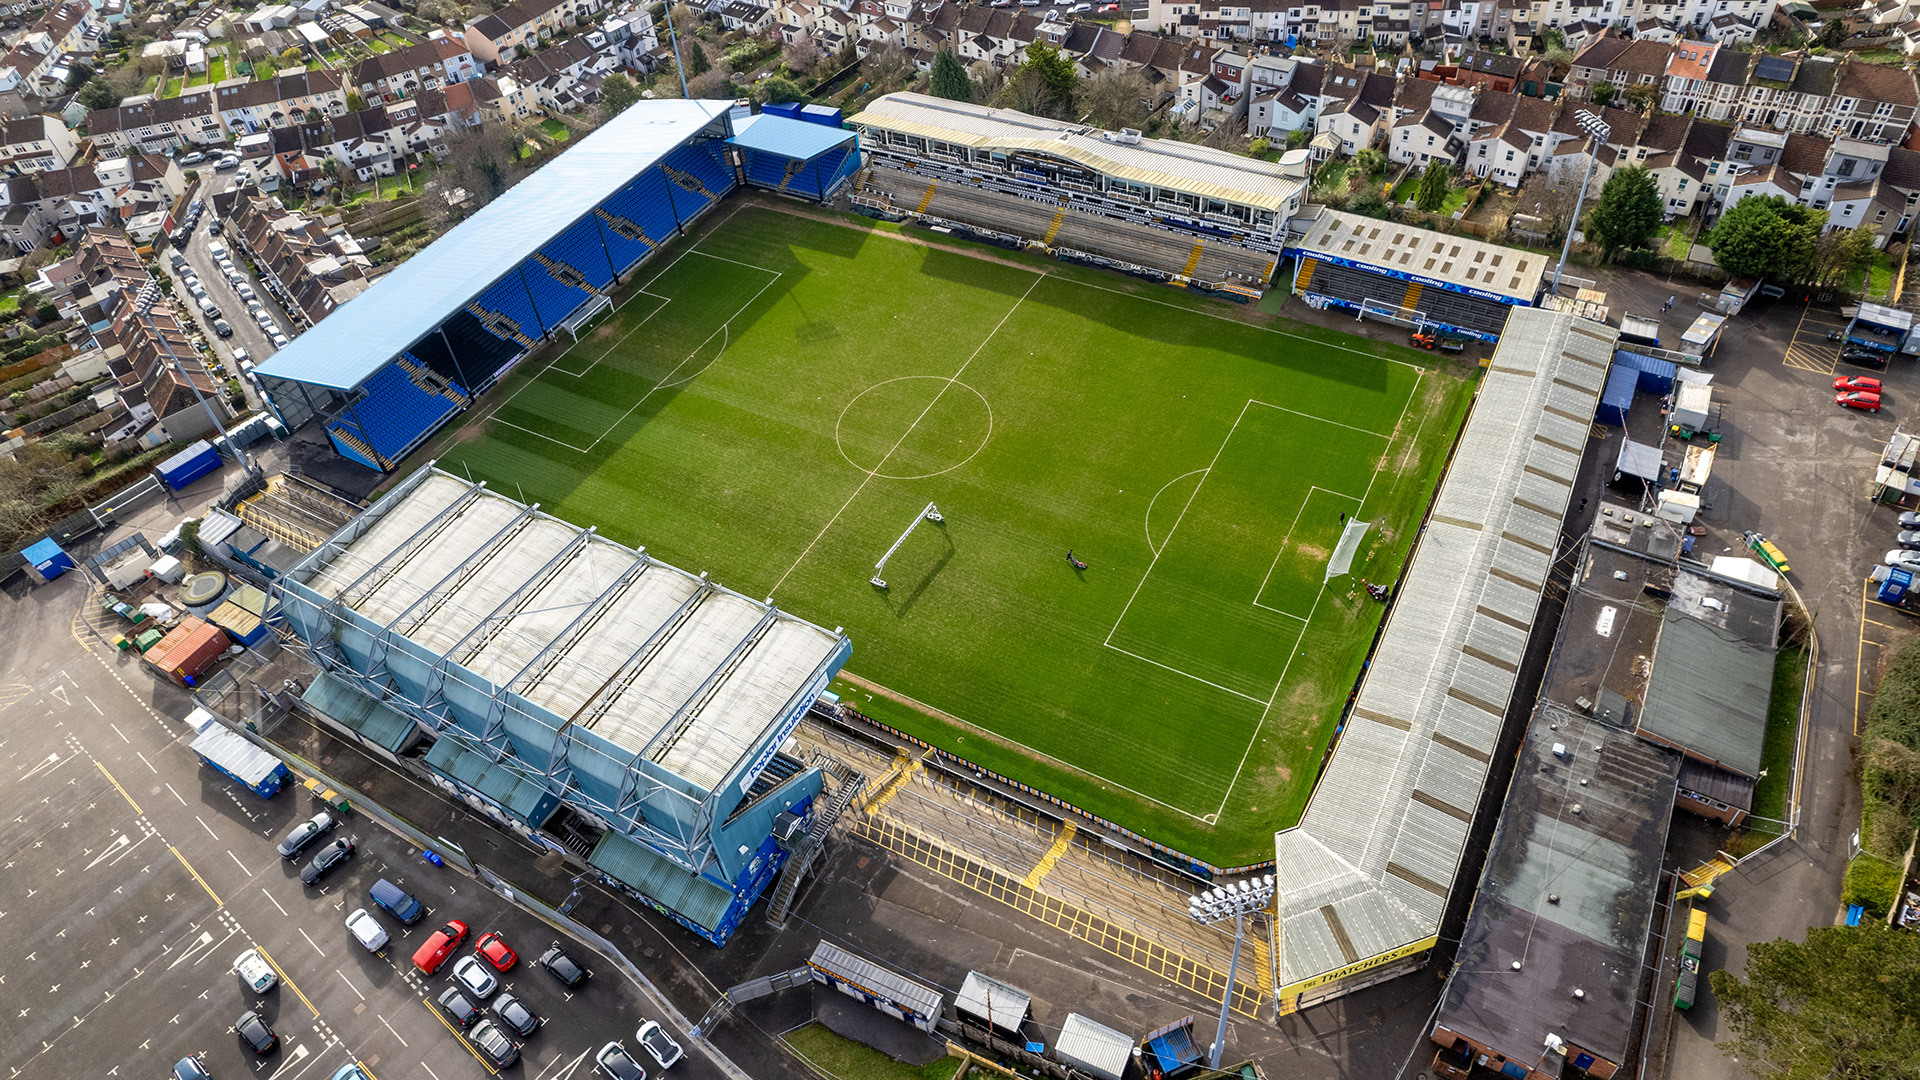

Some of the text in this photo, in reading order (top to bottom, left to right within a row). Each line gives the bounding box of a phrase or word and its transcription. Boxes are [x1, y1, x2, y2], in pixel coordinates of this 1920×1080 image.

[750, 741, 778, 779] Poplar
[777, 693, 815, 743] Insulation
[1303, 947, 1415, 989] THE THATCHERS END
